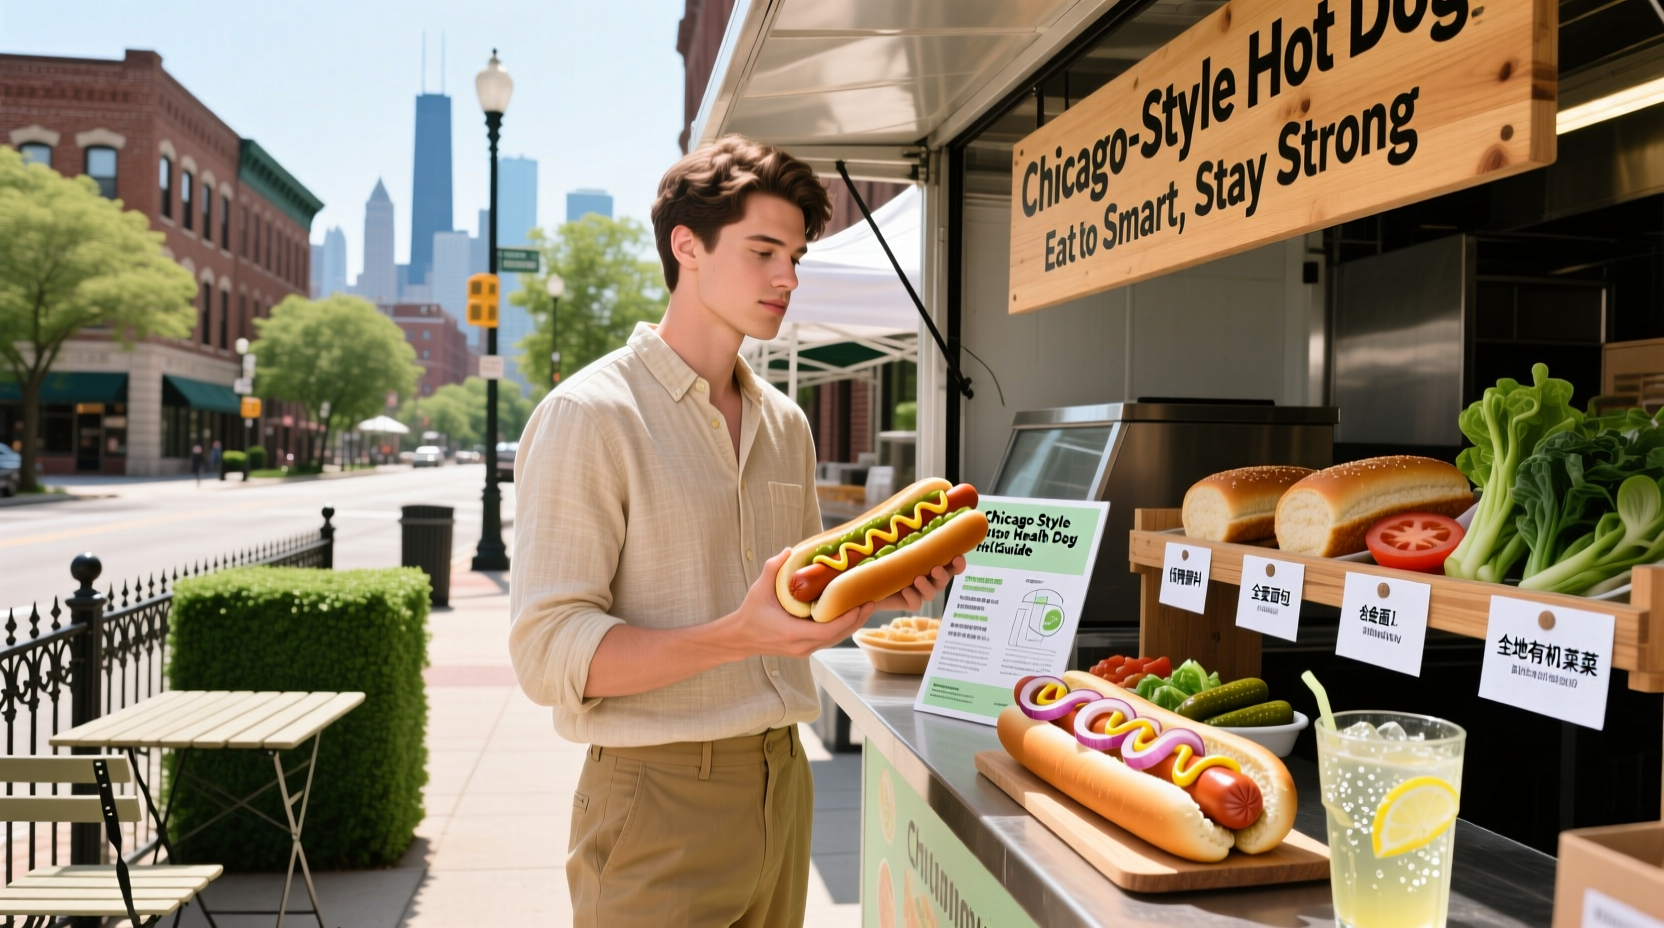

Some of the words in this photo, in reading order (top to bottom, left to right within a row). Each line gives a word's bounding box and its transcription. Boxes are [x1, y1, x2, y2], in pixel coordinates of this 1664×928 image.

[1022, 57, 1236, 218] Chicago-Style
[1248, 0, 1335, 109] Hot
[1045, 224, 1076, 272] Eat
[1080, 221, 1097, 259] to
[1103, 181, 1185, 250] Smart,
[1195, 152, 1268, 218] Stay
[1277, 86, 1420, 186] Strong
[985, 509, 1034, 529] Chicago
[1037, 513, 1071, 531] Style
[1052, 531, 1078, 549] Dog
